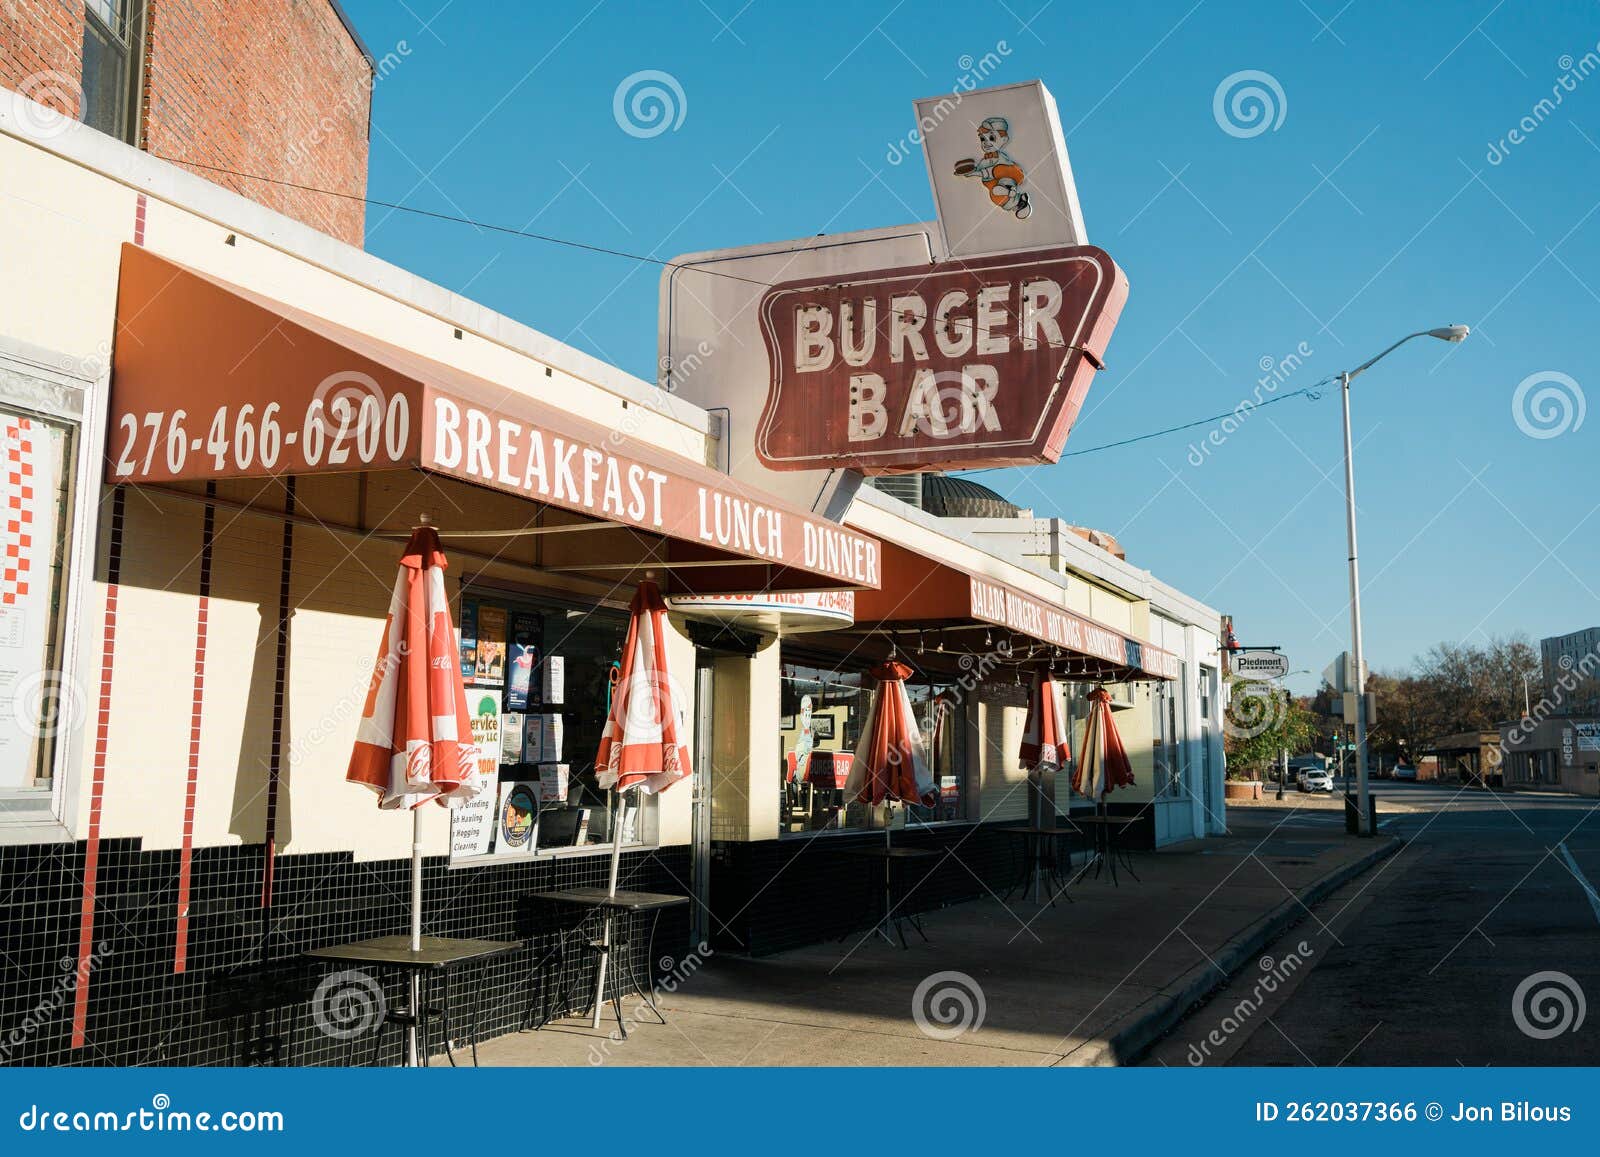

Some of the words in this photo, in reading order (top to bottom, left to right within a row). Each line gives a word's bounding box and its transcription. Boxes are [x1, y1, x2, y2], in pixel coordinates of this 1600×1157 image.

[793, 277, 1065, 373] BURGER
[116, 392, 410, 476] 276-466-6200
[848, 364, 1001, 442] BAR
[433, 397, 668, 527] BREAKFAST
[698, 488, 785, 559] LUNCH
[802, 521, 878, 585] DINNER
[971, 580, 1005, 622] SALADS
[1006, 591, 1043, 636] BURGERS
[1046, 610, 1062, 642] HOT
[1063, 617, 1082, 649] DOGS
[1238, 657, 1282, 672] Piedmont
[470, 716, 498, 730] ervice
[486, 732, 497, 742] LLC
[836, 759, 850, 775] BAR
